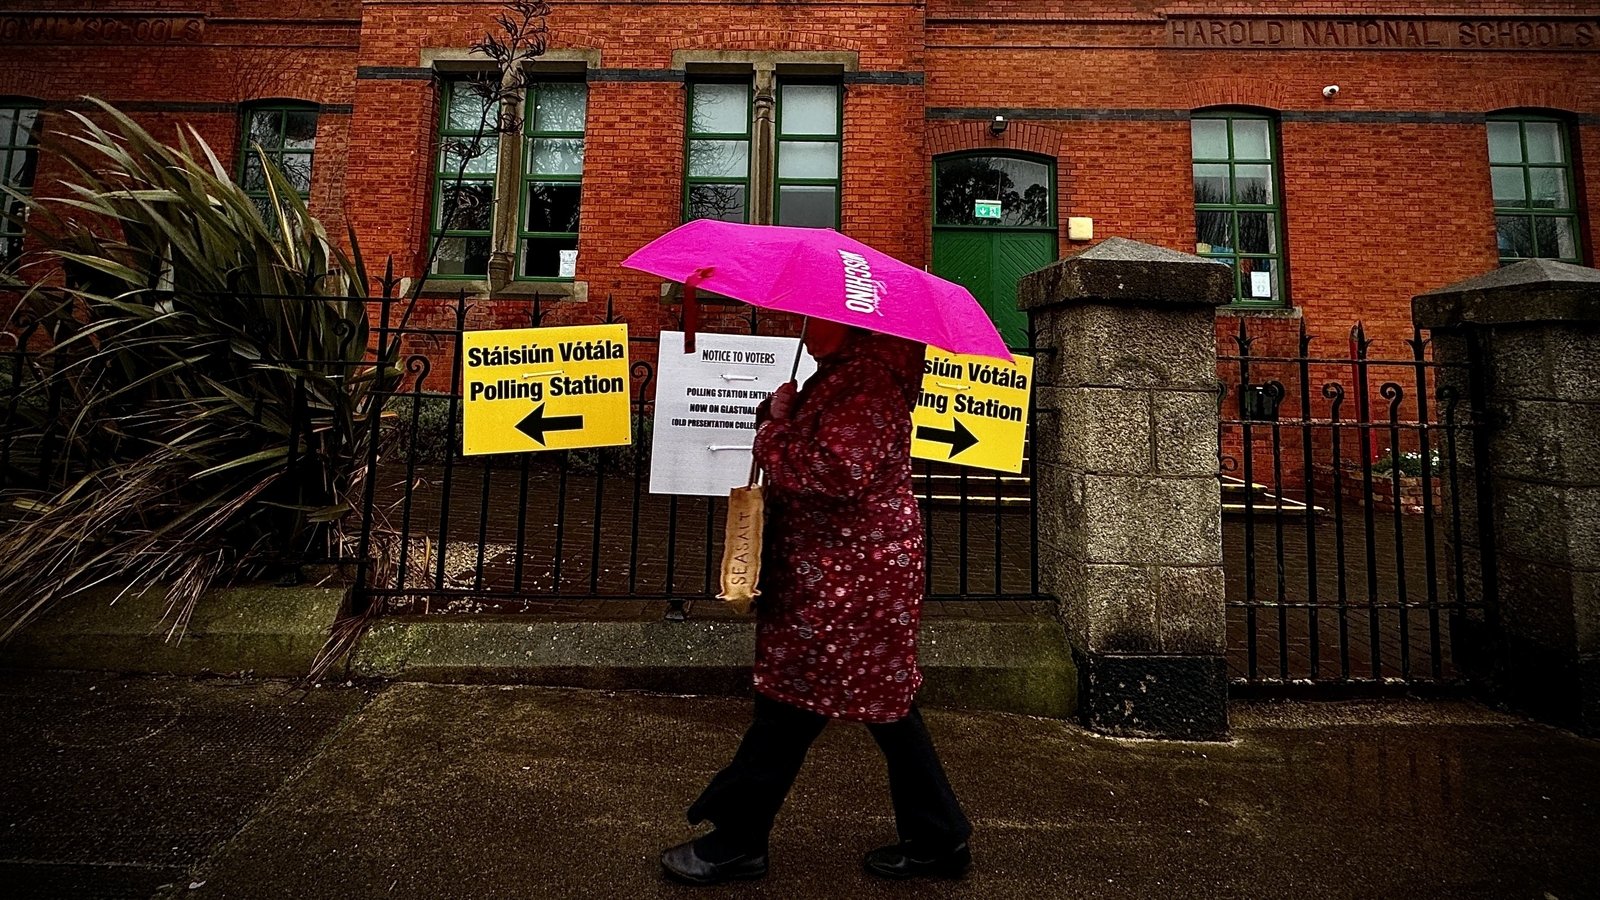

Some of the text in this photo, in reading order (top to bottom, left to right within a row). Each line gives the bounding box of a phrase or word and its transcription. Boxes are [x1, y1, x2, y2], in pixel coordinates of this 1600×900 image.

[2, 17, 201, 40] ONAL SCHOOLS
[1171, 20, 1595, 49] HAROLD NATIONAL SCHOOLS
[468, 340, 624, 367] Stáisiún Vótála
[702, 349, 775, 364] NOTICE TO VOTERS
[924, 357, 1027, 390] siún Vótála
[470, 375, 624, 402] Polling Station
[686, 387, 716, 397] POLLING
[717, 389, 748, 399] STATION
[689, 403, 708, 413] NOW
[709, 404, 719, 413] ON
[953, 393, 1023, 422] Station
[687, 419, 734, 429] PRESENTATION
[735, 421, 757, 430] COLLEG
